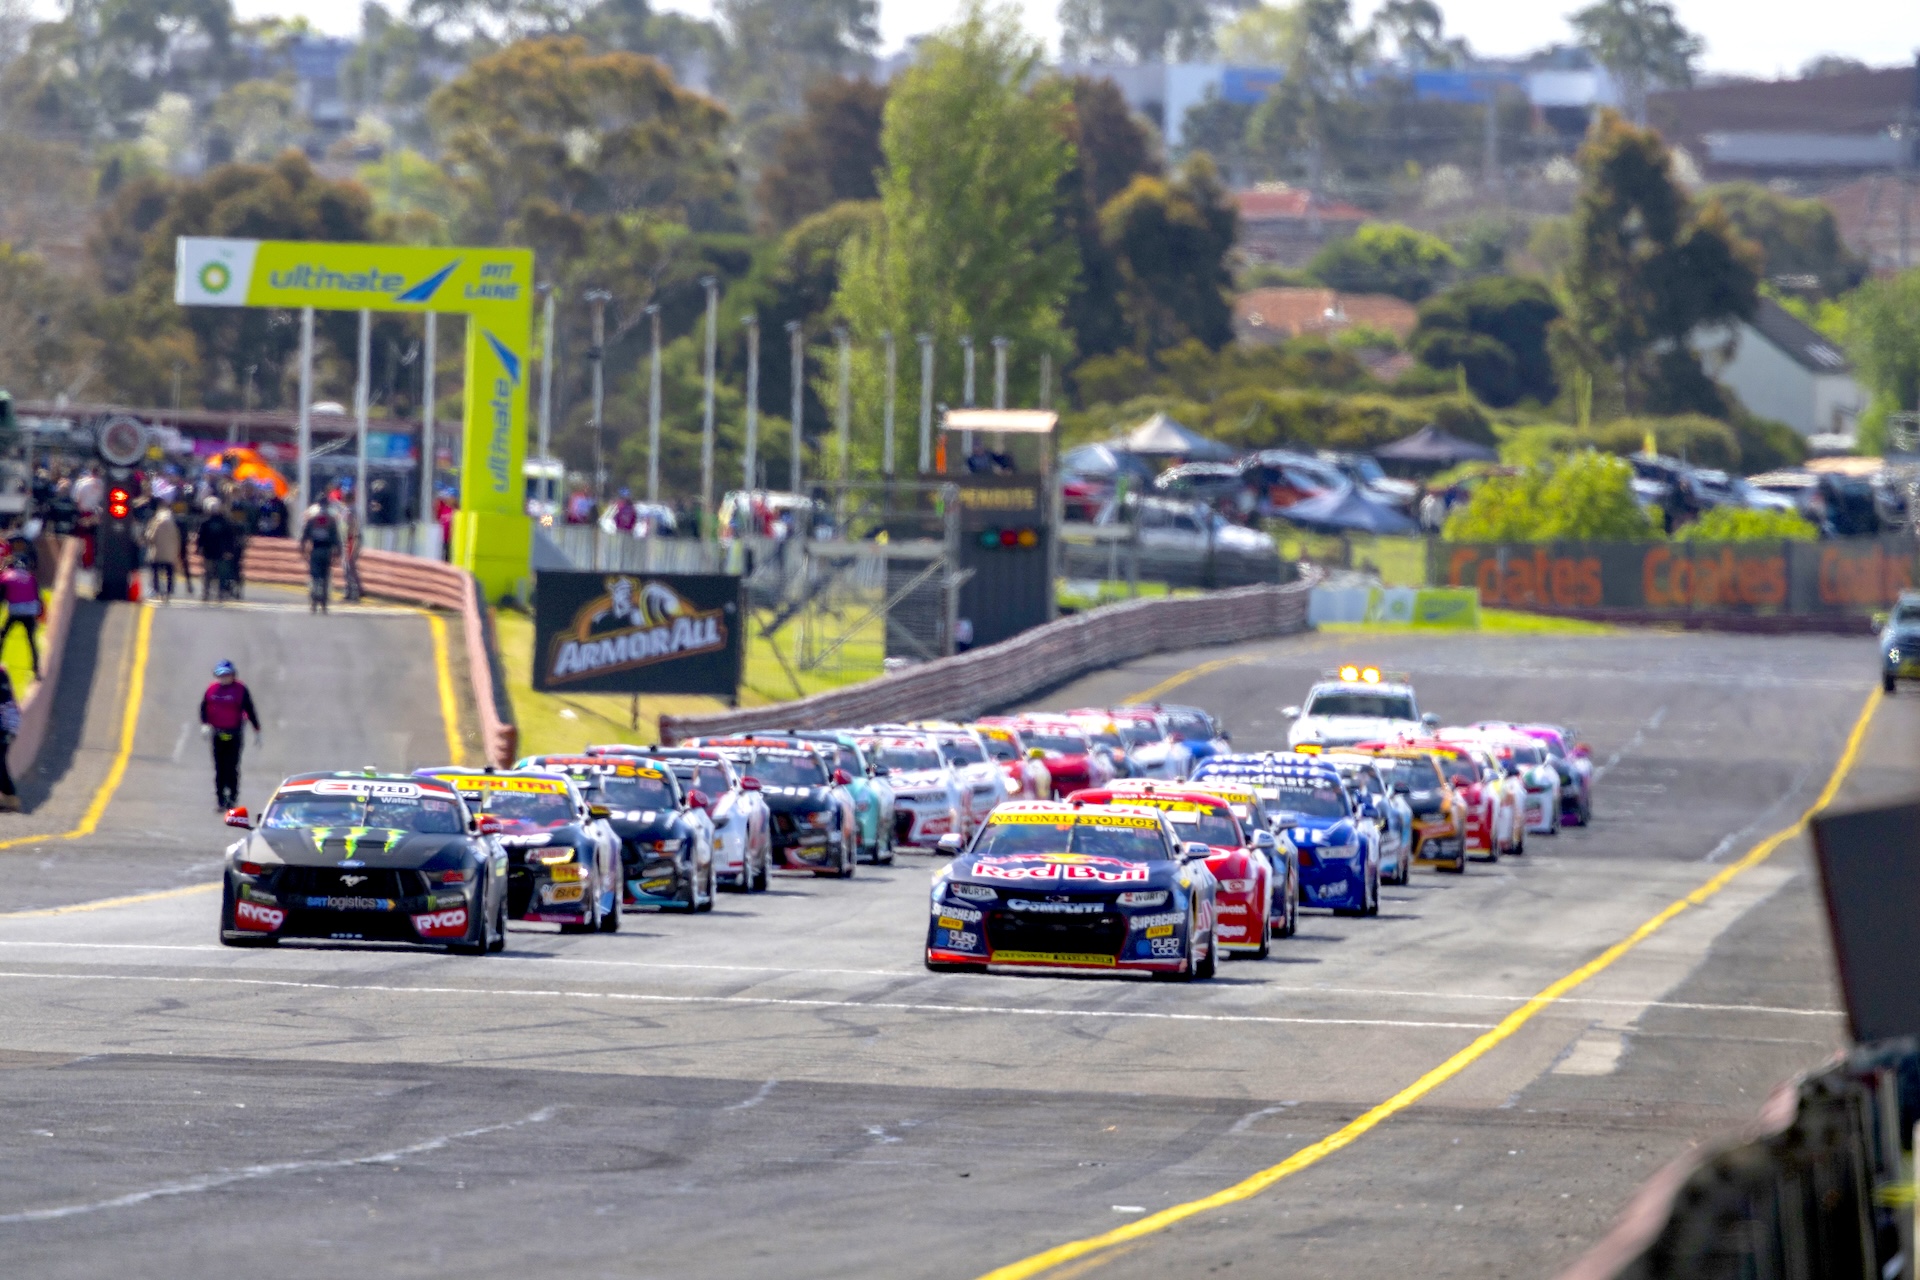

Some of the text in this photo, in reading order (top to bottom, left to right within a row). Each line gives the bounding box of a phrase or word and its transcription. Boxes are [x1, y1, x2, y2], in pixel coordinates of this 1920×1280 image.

[269, 264, 405, 292] ultimate
[480, 263, 515, 280] PIT
[463, 282, 520, 300] LANE
[488, 377, 511, 493] ultimate
[1450, 548, 1602, 603] Coates
[1641, 546, 1788, 606] Coates
[351, 784, 410, 793] ENZED
[1202, 774, 1306, 788] Steadfast
[380, 796, 418, 806] Waters
[994, 814, 1071, 824] NATIONAL
[1079, 816, 1156, 828] STORAGE
[1095, 826, 1134, 834] Brown
[972, 863, 1150, 882] Red Bull
[238, 901, 283, 925] RYCO
[416, 909, 466, 930] RYCO
[932, 904, 982, 923] SUPERCHEAP
[1130, 912, 1185, 931] SUPERCHEAP
[949, 930, 977, 943] QUAD
[1149, 927, 1170, 936] AUTO
[947, 940, 975, 951] LOCK
[1151, 938, 1179, 947] QUAD
[1151, 946, 1179, 956] LOCK
